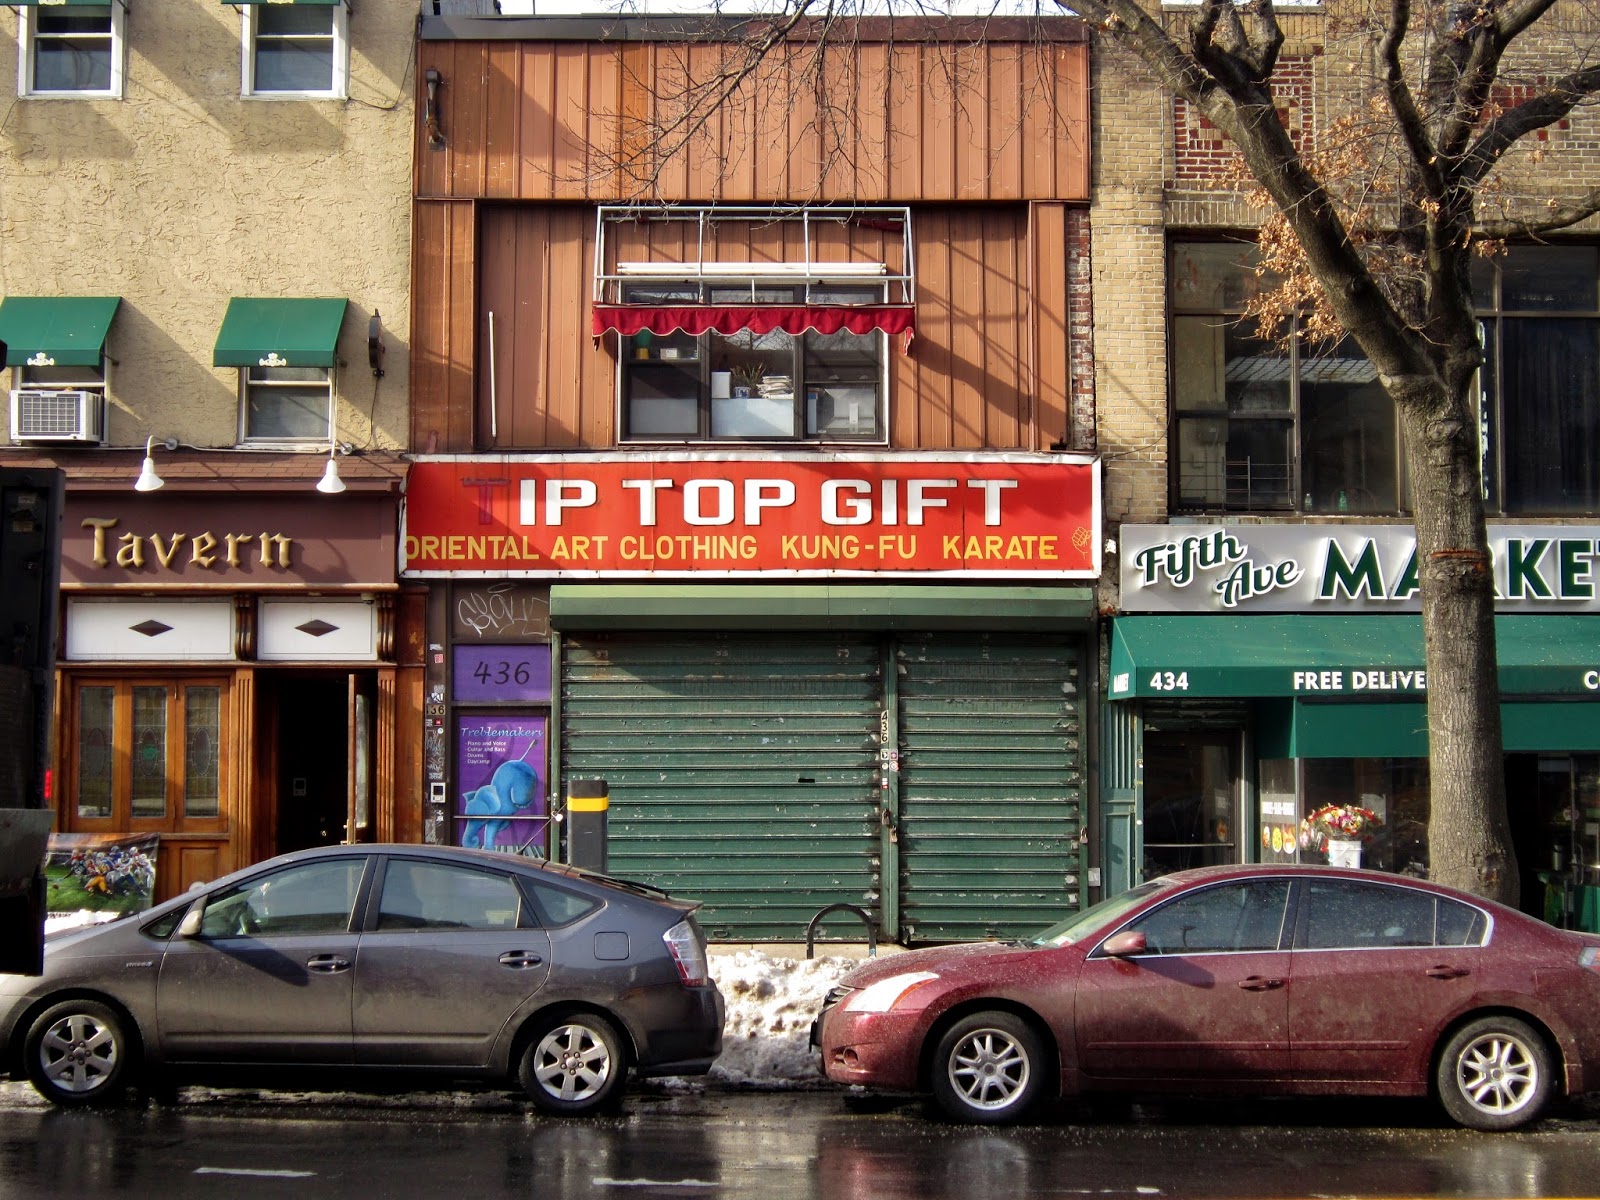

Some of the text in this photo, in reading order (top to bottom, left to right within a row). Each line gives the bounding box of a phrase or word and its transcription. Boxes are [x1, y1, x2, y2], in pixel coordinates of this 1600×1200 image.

[622, 478, 796, 526] TOP
[820, 478, 1018, 526] GIFT
[81, 517, 293, 568] Tavern
[406, 535, 1058, 560] ORIENTAL ART CLOTHING KUNG-FU KARATE
[1134, 528, 1248, 587] Fifth
[1316, 536, 1600, 600] MKE
[1213, 559, 1305, 608] Ave
[473, 661, 531, 685] 436
[1149, 671, 1189, 691] 434
[1293, 670, 1429, 690] FREE DELIVE
[426, 704, 446, 715] 36
[461, 726, 544, 738] Treblemakers
